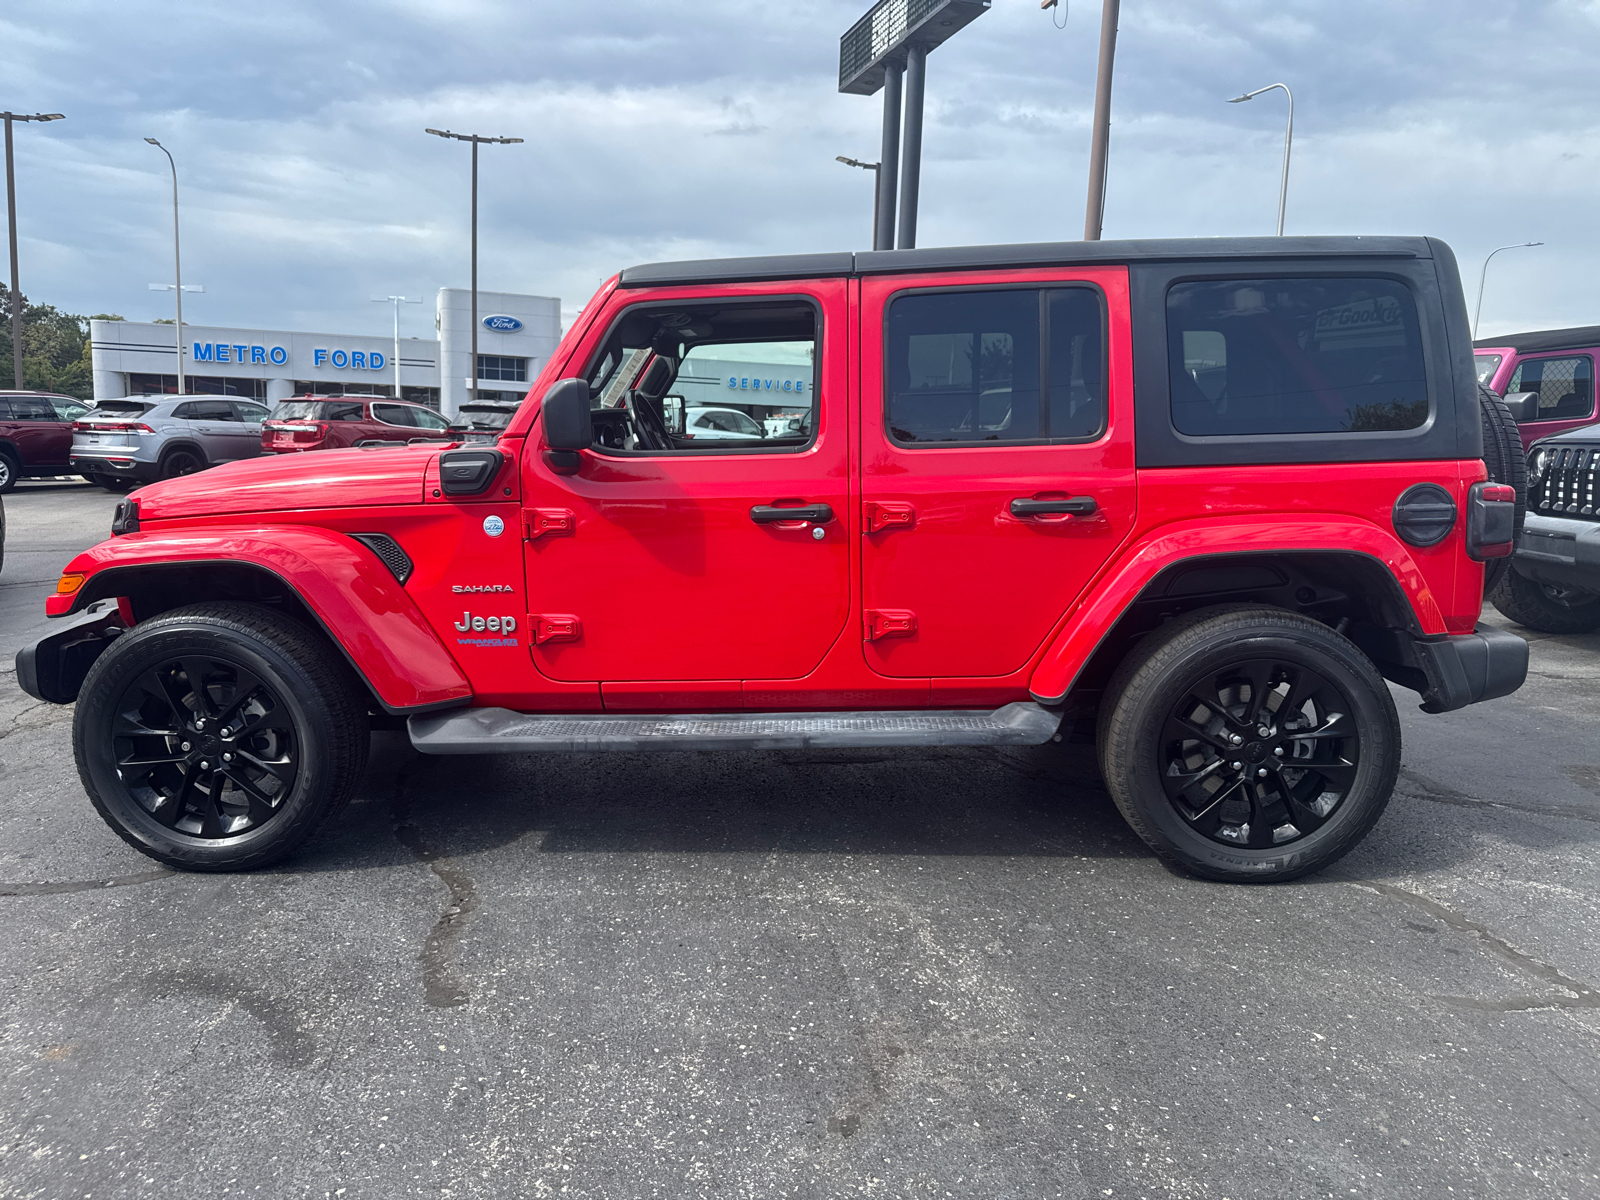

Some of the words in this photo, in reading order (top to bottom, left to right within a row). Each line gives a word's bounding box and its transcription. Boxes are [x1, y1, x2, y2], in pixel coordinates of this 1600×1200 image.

[491, 318, 516, 329] Ford
[193, 342, 288, 365] METRO
[313, 348, 385, 370] FORD
[728, 376, 804, 393] SERVICE
[452, 584, 514, 593] SAHARA
[454, 611, 516, 636] Jeep
